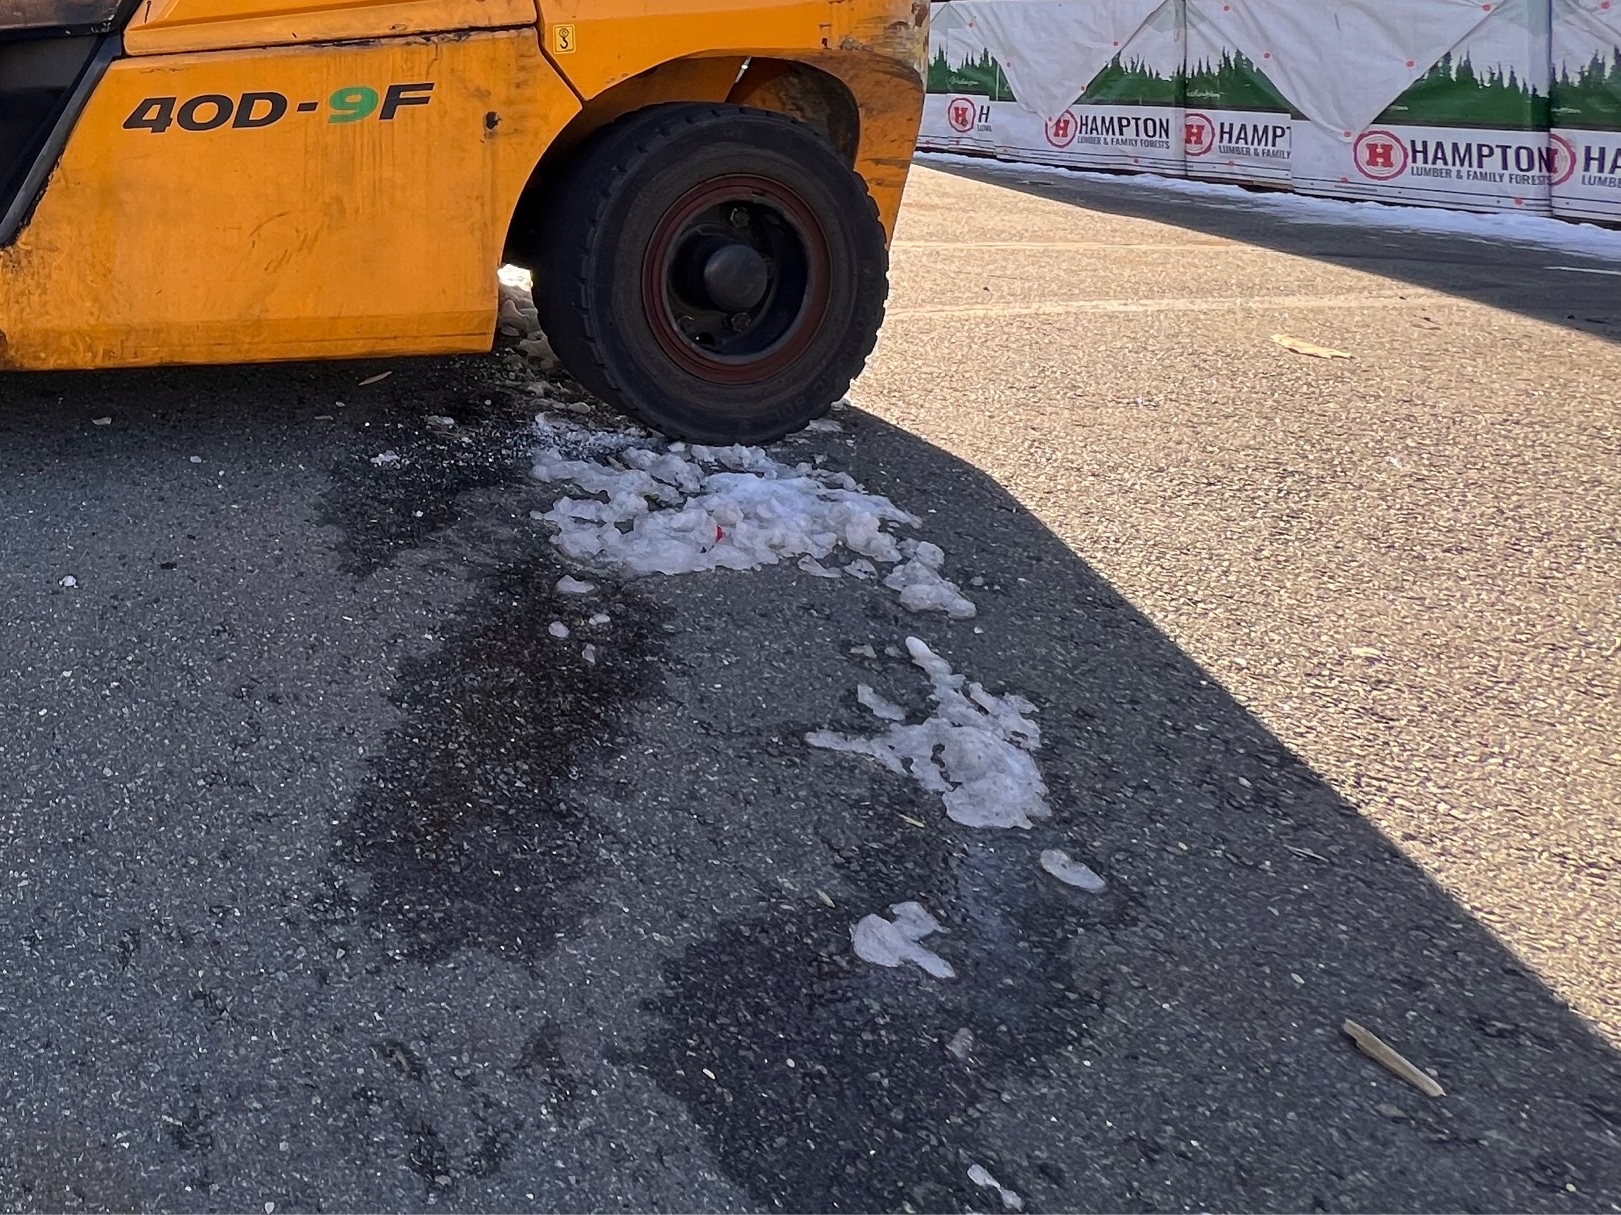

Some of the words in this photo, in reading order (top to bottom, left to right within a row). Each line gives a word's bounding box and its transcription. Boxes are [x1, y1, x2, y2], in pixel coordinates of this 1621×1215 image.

[122, 81, 436, 134] 40D-9F
[1079, 115, 1169, 140] HAMPTON
[1140, 139, 1170, 149] FORESTS
[1218, 145, 1251, 156] LUMBER
[1262, 148, 1291, 160] FAMILY
[1410, 139, 1552, 174] HAMPTON
[1411, 166, 1453, 180] LUMBER
[1456, 168, 1463, 180] &
[1466, 169, 1505, 184] FAMILY
[1508, 172, 1552, 186] FORESTS
